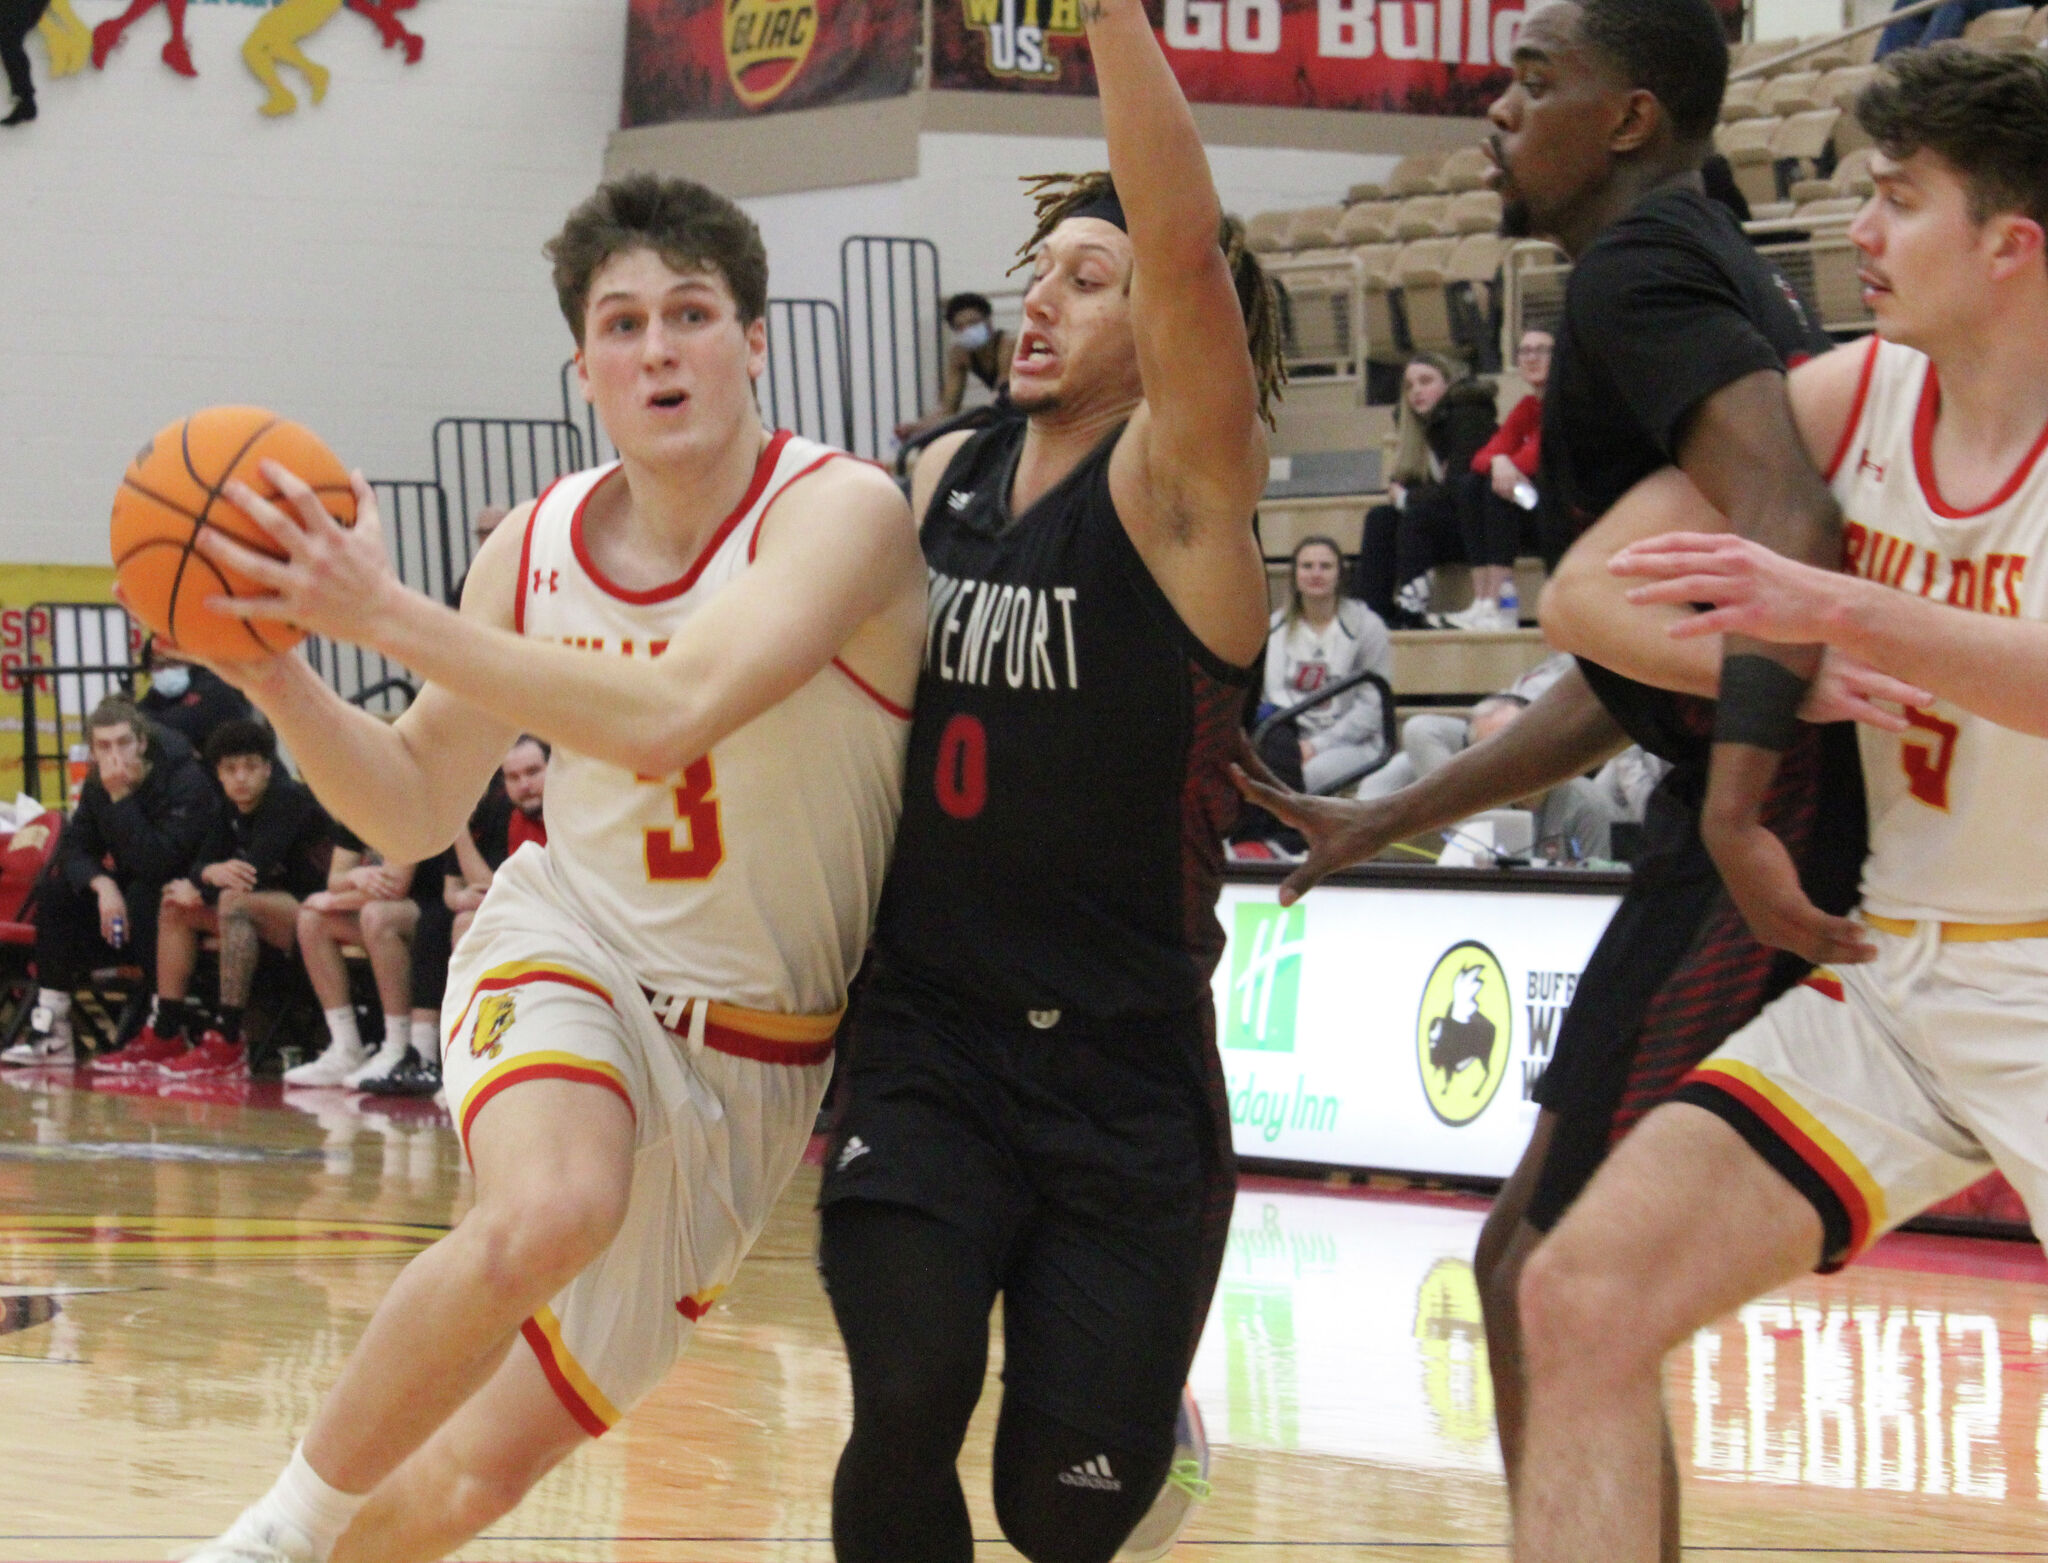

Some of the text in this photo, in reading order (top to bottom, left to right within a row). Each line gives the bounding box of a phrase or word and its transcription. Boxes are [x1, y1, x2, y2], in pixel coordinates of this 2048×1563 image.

[1164, 0, 1282, 54] Go
[934, 713, 988, 819] 0
[634, 751, 726, 883] 3
[1290, 1073, 1340, 1132] Inn
